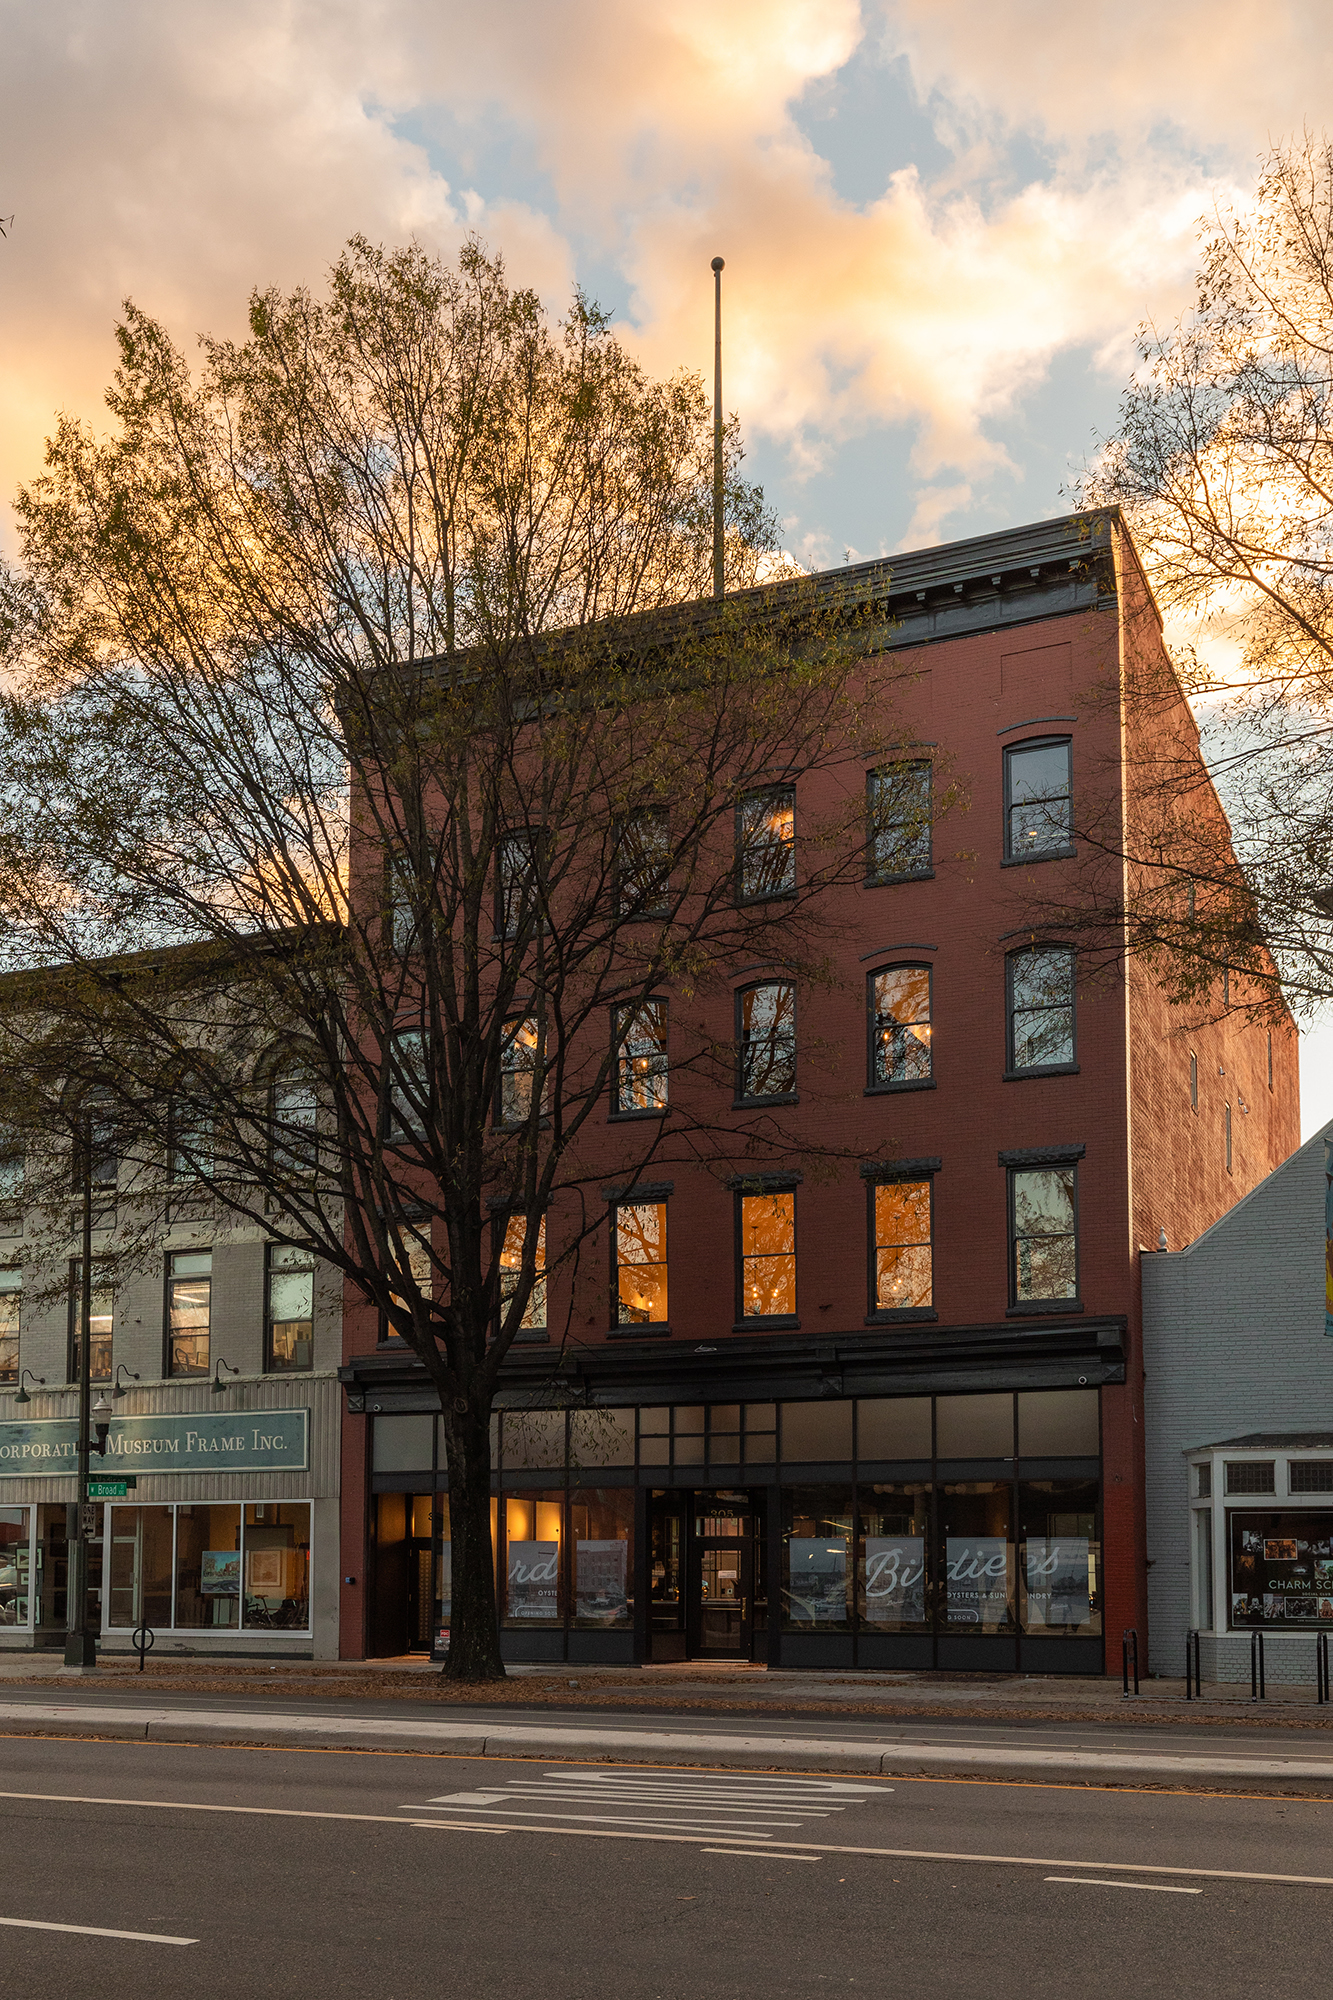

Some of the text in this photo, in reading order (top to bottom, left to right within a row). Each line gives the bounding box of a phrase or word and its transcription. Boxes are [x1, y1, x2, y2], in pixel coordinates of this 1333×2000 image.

[98, 1484, 117, 1495] Broad
[1268, 1580, 1333, 1590] CHARM SC
[990, 1591, 1007, 1599] SUN
[397, 1771, 895, 1838] ONLY
